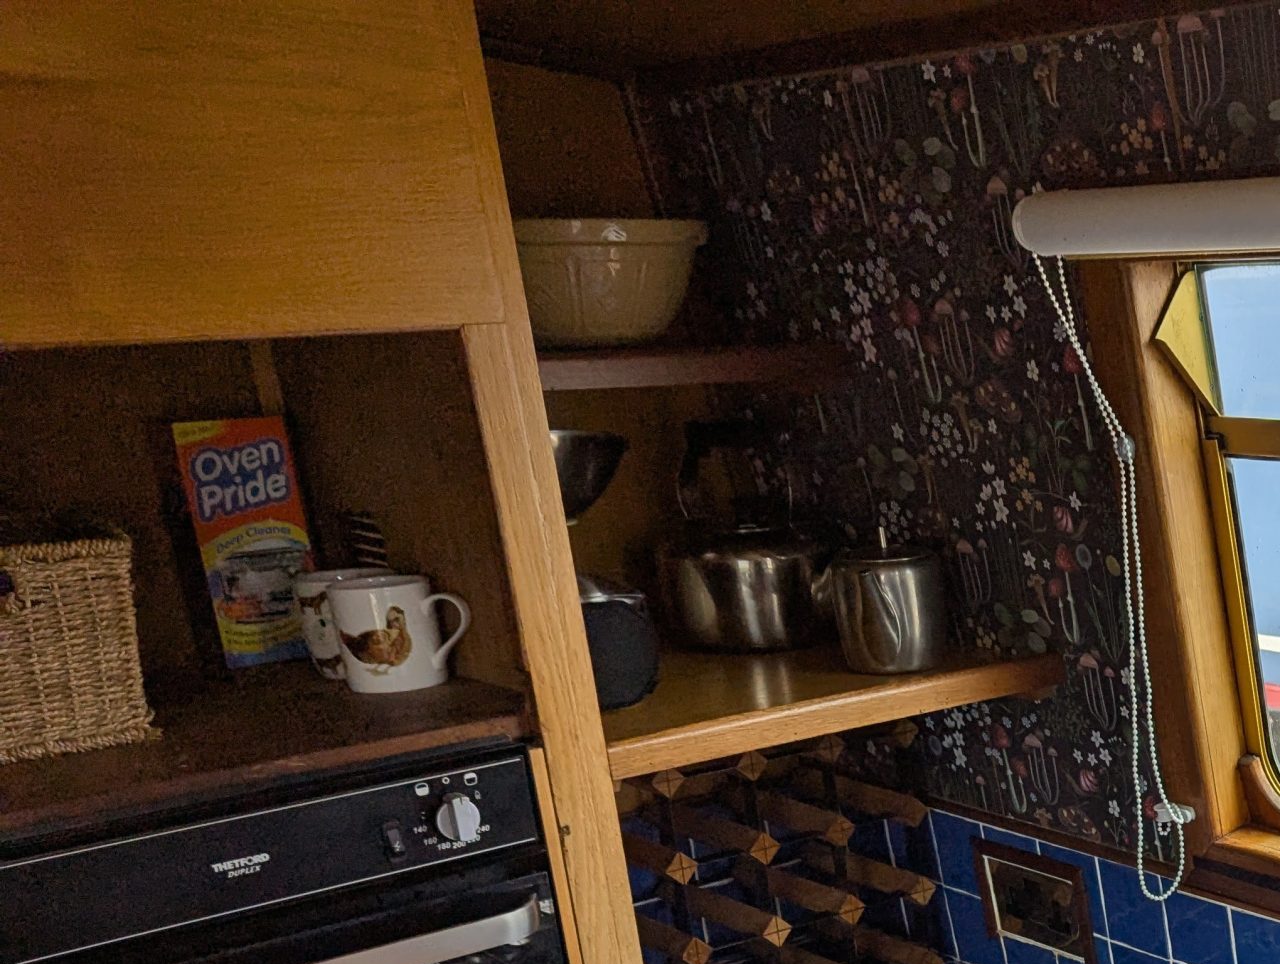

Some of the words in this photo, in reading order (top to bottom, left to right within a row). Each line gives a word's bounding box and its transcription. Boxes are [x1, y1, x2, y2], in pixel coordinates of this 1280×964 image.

[195, 441, 280, 481] Oven
[200, 470, 287, 517] Pride
[211, 853, 270, 872] THETFORD
[228, 865, 261, 878] DUPLEX
